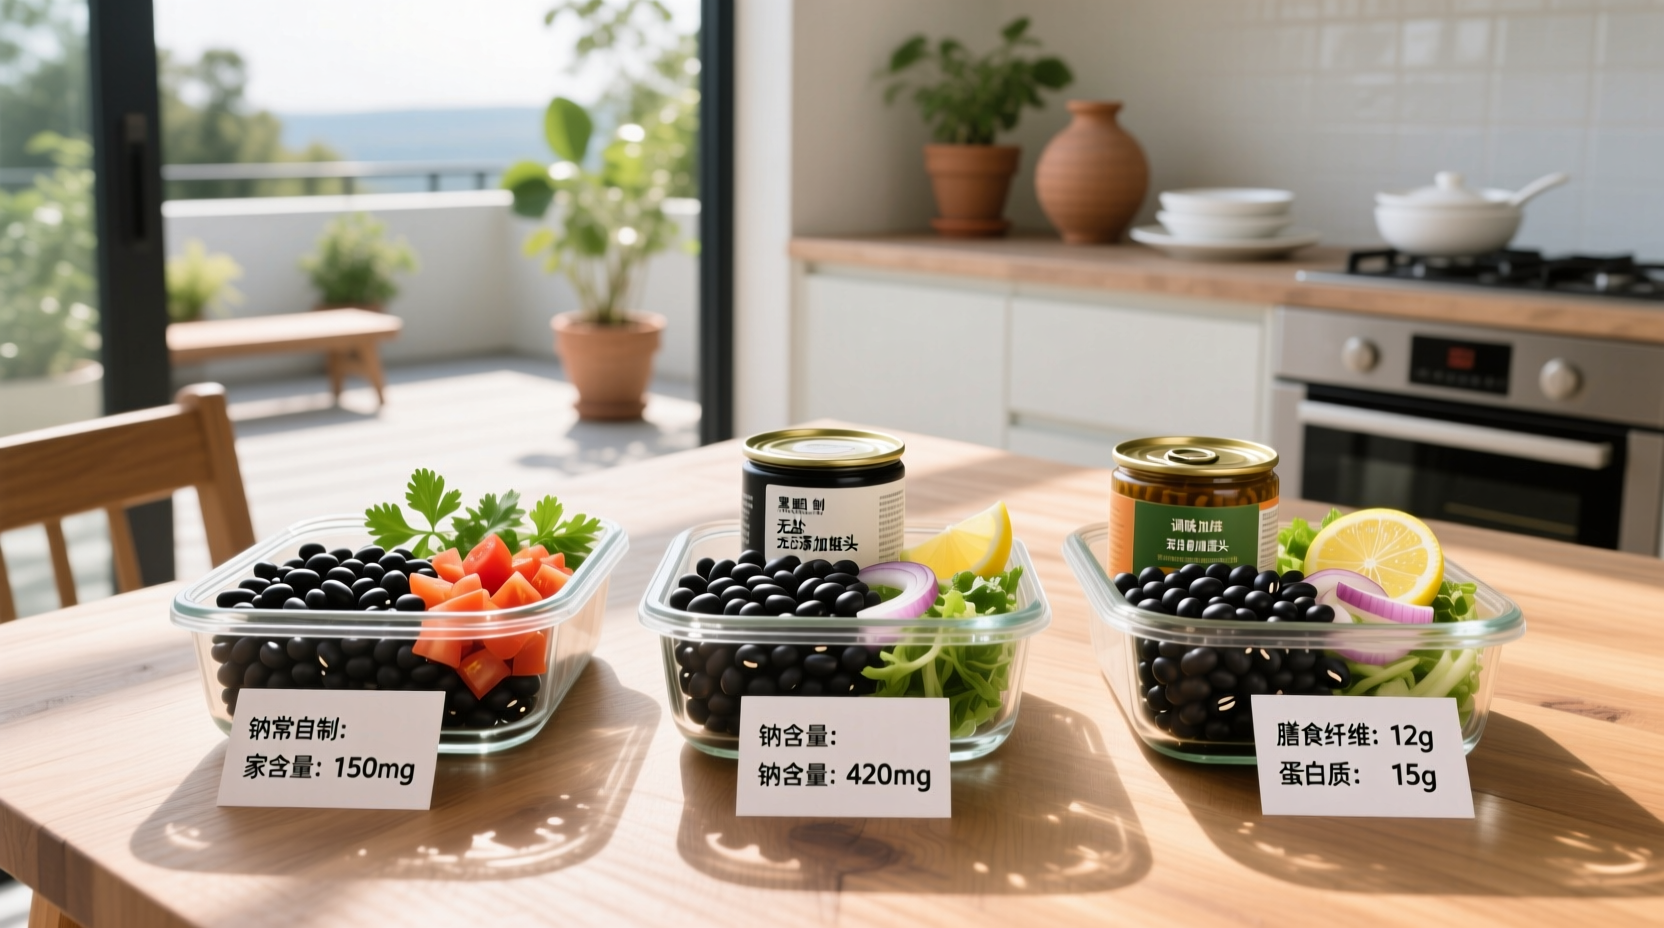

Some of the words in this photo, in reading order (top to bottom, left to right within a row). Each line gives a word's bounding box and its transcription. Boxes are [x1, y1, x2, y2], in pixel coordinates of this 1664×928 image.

[248, 715, 347, 742] 钠常自制：
[758, 723, 836, 748] 钠含量：
[1276, 720, 1379, 747] 膳食纤维：
[1390, 724, 1434, 754] 12g
[242, 752, 322, 780] 家含量：
[334, 756, 416, 786] 150mg
[757, 761, 836, 787] 钠含量：
[845, 762, 931, 793] 420mg
[1279, 760, 1360, 787] 蛋白质：
[1391, 762, 1437, 793] 15g
